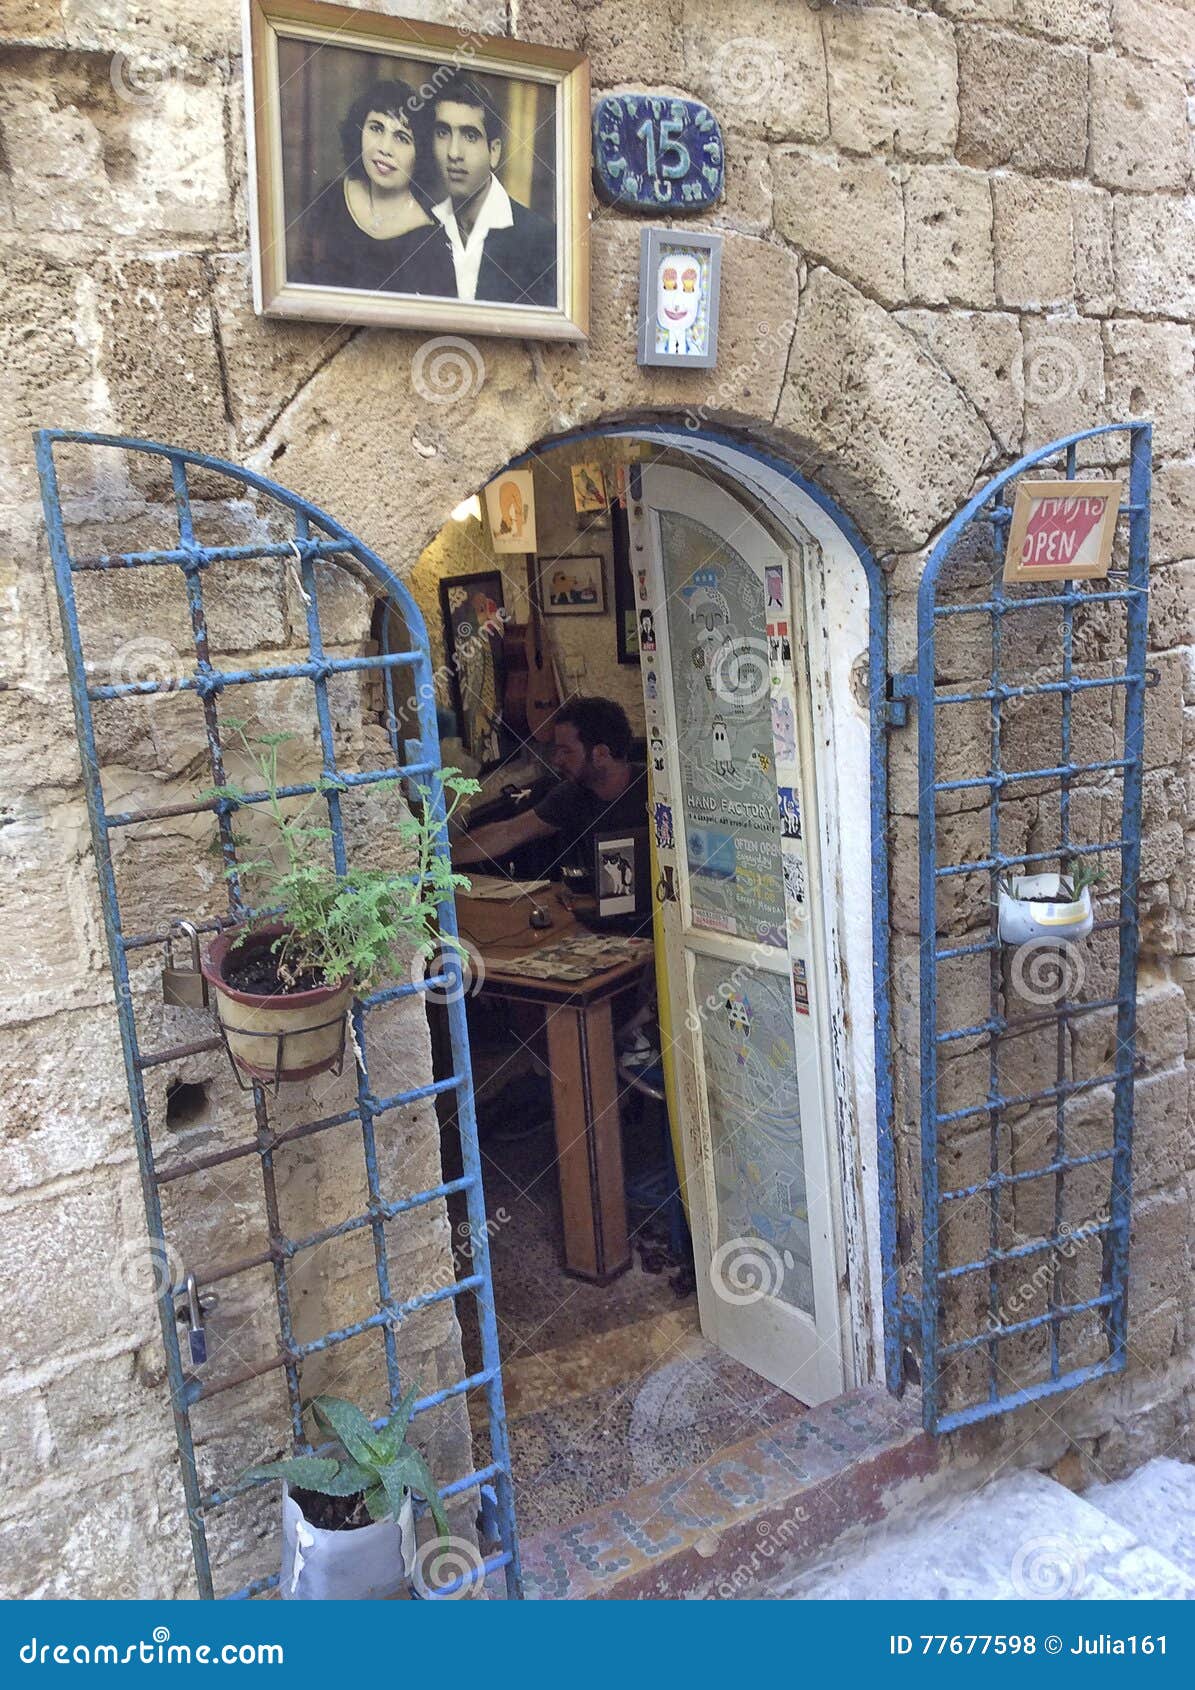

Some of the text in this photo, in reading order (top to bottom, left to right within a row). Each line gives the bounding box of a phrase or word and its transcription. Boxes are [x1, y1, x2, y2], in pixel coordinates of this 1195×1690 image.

[637, 119, 691, 179] 15
[1022, 530, 1076, 562] OPEN
[687, 795, 773, 821] HAND FACTORY
